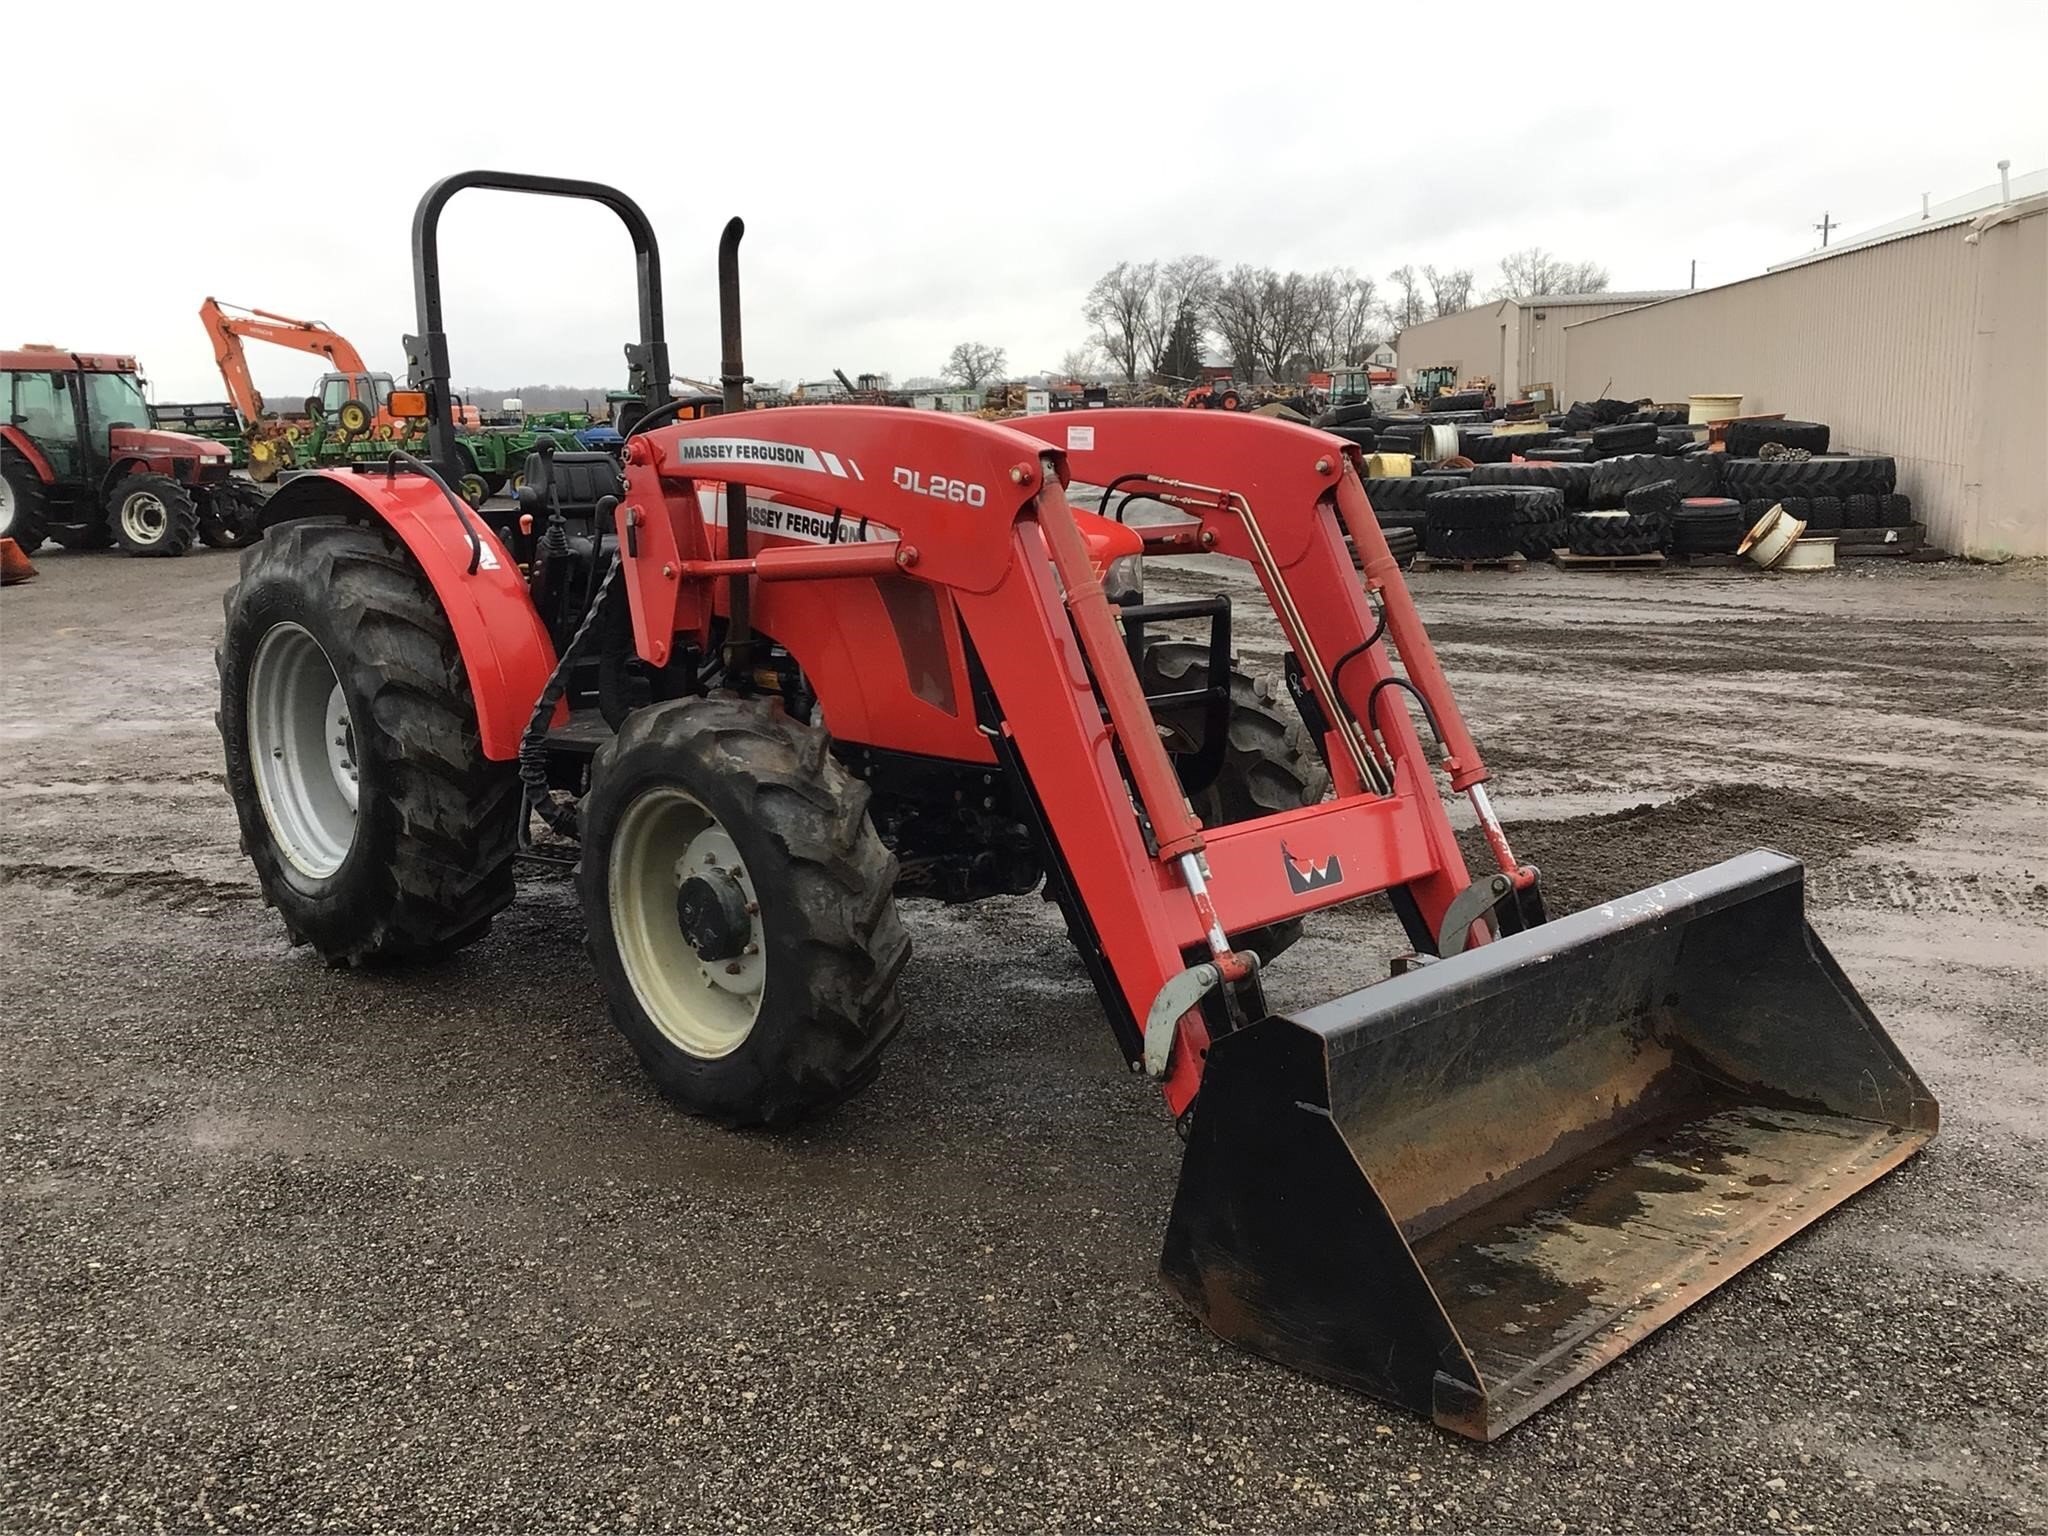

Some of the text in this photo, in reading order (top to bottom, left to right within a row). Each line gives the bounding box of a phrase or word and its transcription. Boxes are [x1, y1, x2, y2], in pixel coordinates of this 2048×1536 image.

[683, 445, 804, 465] MASSEY FERGUSON
[893, 466, 986, 507] DL260
[746, 506, 783, 530] ASSEY
